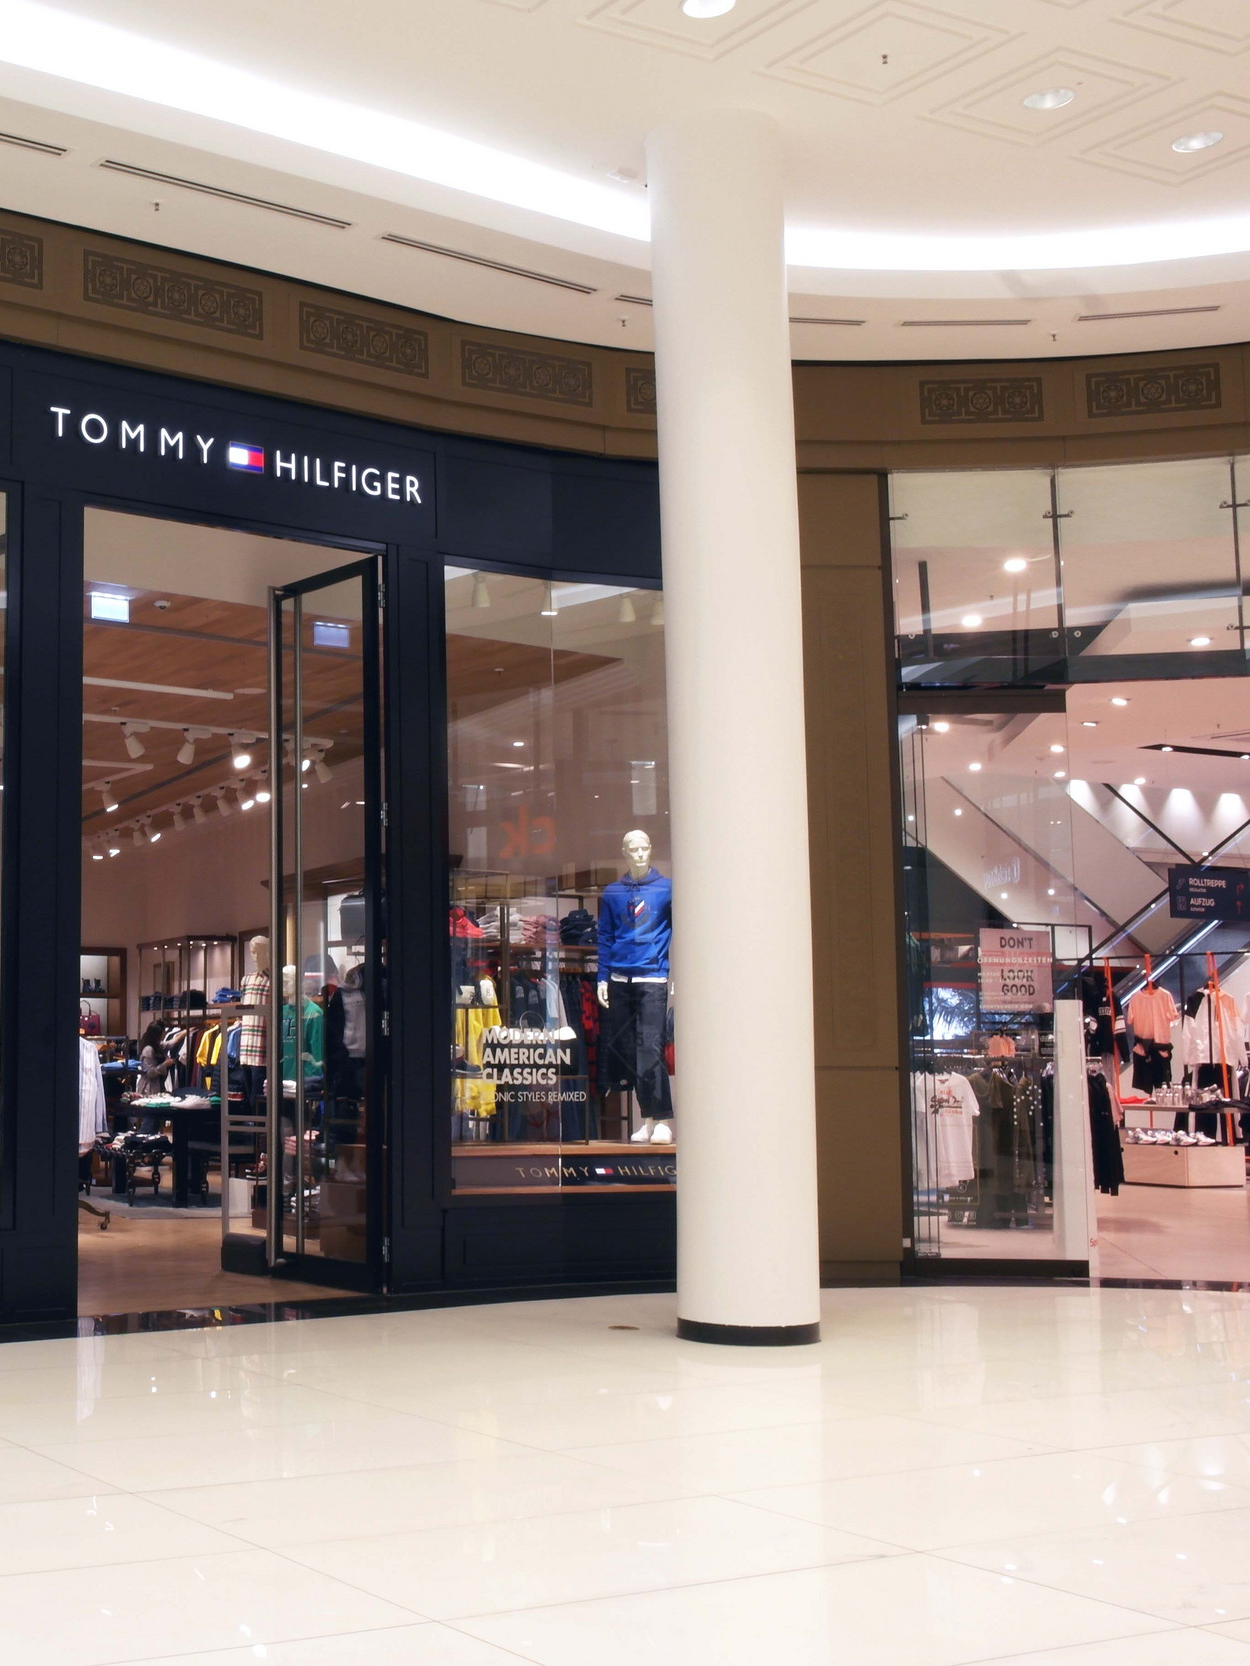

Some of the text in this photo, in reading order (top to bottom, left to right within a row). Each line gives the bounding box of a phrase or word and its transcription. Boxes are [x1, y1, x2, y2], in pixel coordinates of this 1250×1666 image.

[50, 406, 422, 503] TOMMY HILFIGER
[1188, 877, 1227, 889] ROLLTREPPE
[1190, 897, 1215, 907] AUFZUG
[999, 936, 1034, 949] DON'T
[1000, 968, 1034, 982] LOOK
[1001, 983, 1036, 997] GOOD
[482, 1027, 556, 1045] MODERN
[482, 1047, 571, 1066] AMERICAN
[482, 1067, 557, 1086] CLASSICS
[488, 1091, 587, 1103] ONIC STYLES REMIXED
[515, 1165, 677, 1179] TOMMY HILFIG
